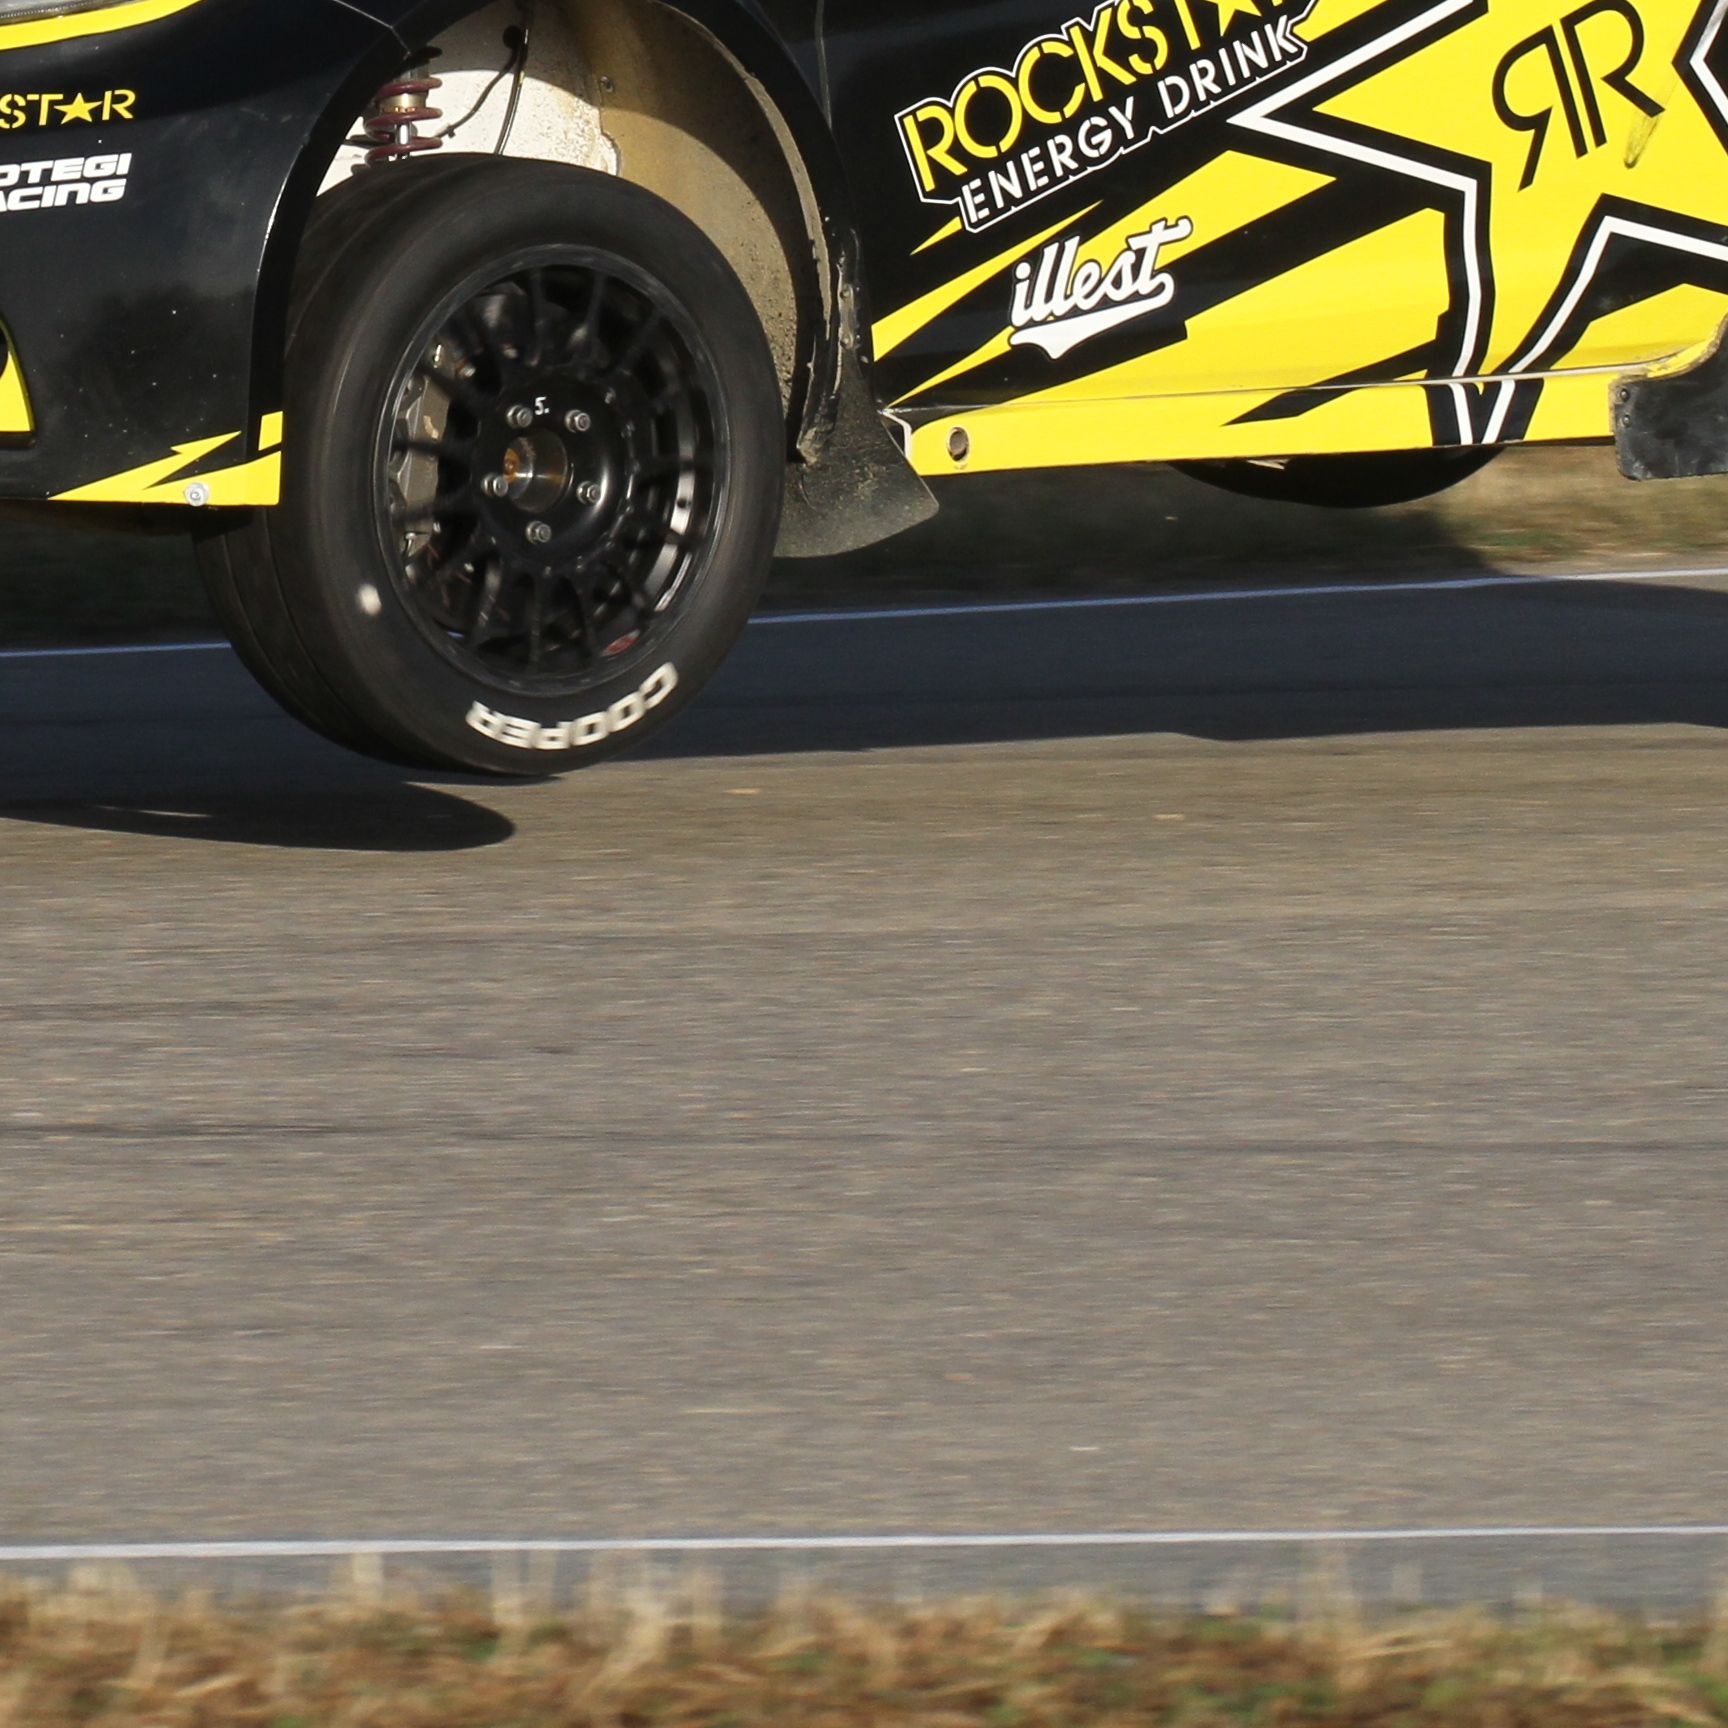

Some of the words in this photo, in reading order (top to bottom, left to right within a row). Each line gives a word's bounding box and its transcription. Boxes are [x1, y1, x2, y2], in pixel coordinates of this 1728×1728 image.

[962, 95, 1135, 223] ENERGY
[1157, 14, 1298, 119] DRINK
[1009, 215, 1193, 359] illest
[468, 661, 678, 751] COOPER
